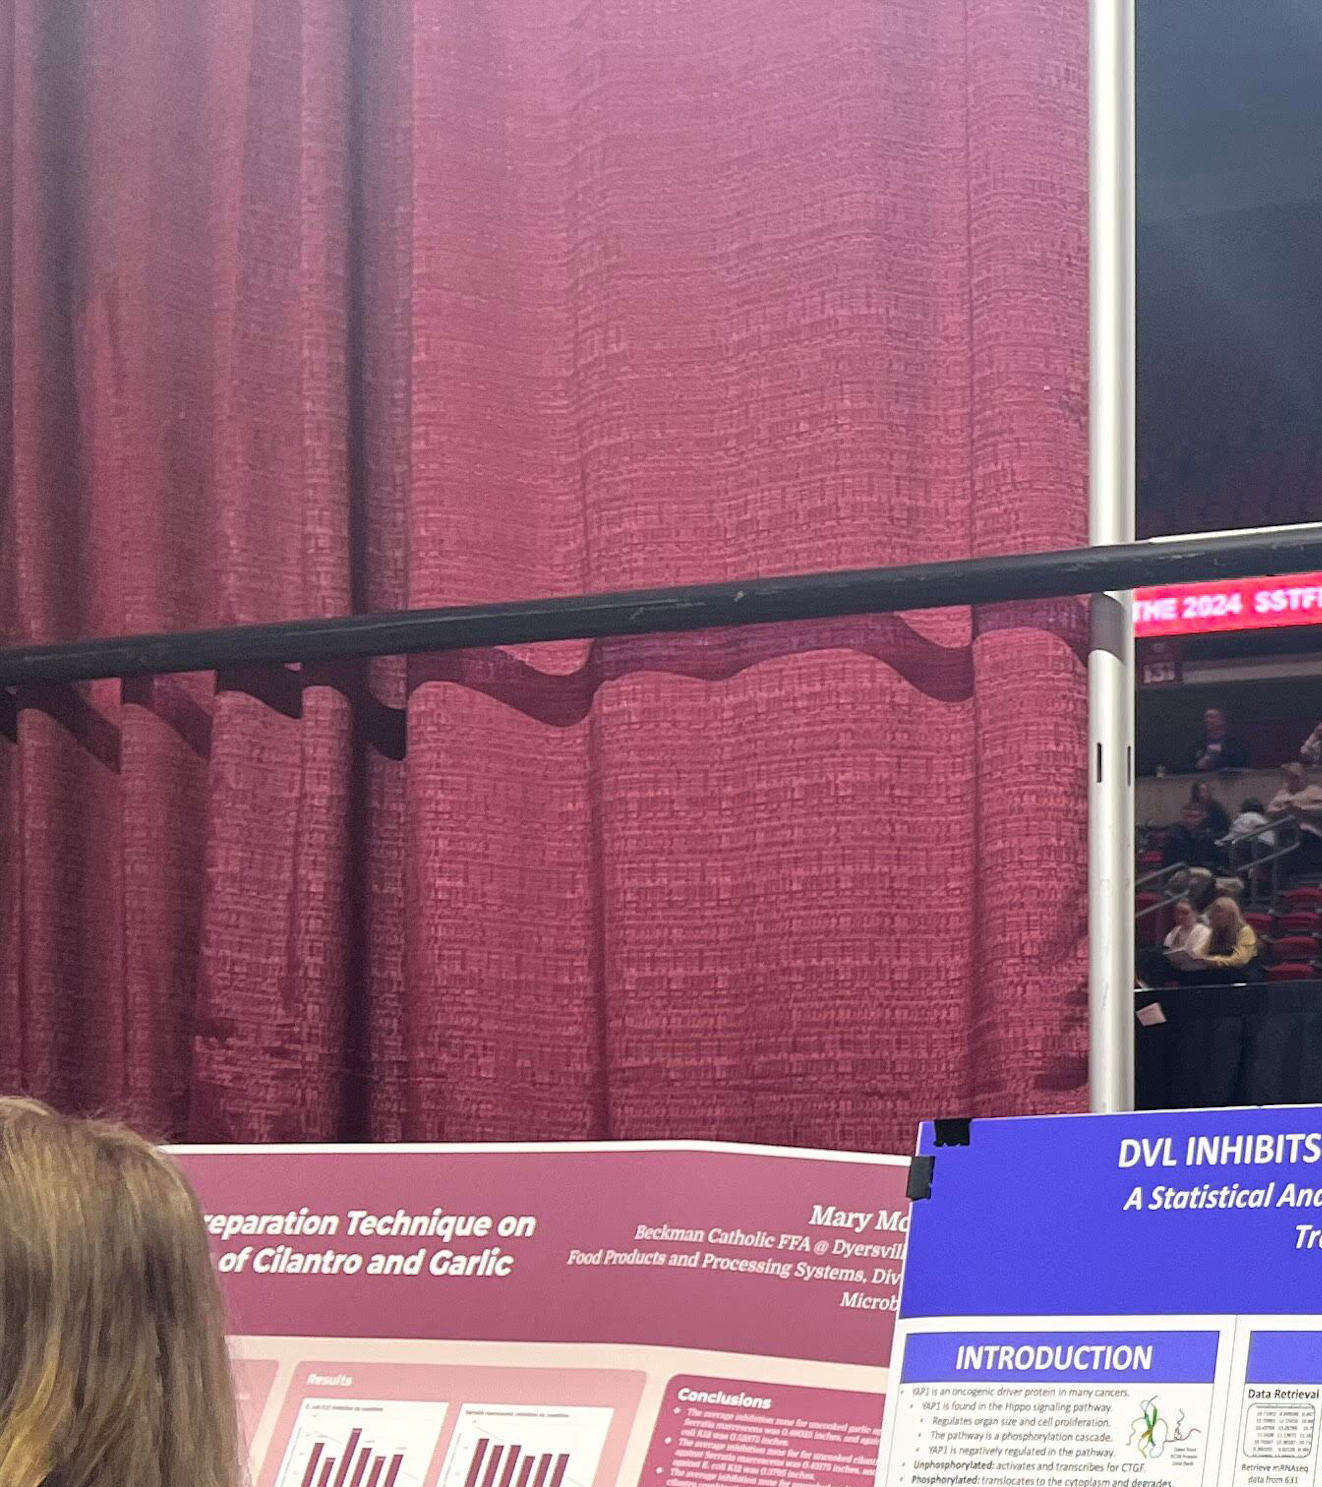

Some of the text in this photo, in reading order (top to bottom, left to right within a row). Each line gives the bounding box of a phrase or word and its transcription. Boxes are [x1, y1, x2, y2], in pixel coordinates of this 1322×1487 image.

[1184, 594, 1241, 617] 2024
[1119, 1138, 1177, 1167] DVL
[1186, 1133, 1321, 1165] INHIBITS
[1123, 1187, 1142, 1210] A
[1148, 1182, 1275, 1210] Statistical
[347, 1208, 492, 1242] Technique
[498, 1216, 536, 1238] on
[809, 1205, 873, 1233] Mary
[634, 1224, 810, 1252] Beckman Catholic FFA
[219, 1245, 514, 1277] of Cilantro and Garlic
[956, 1345, 1152, 1370] INTRODUCTION
[307, 1374, 352, 1386] Results
[677, 1388, 772, 1410] Conclusions
